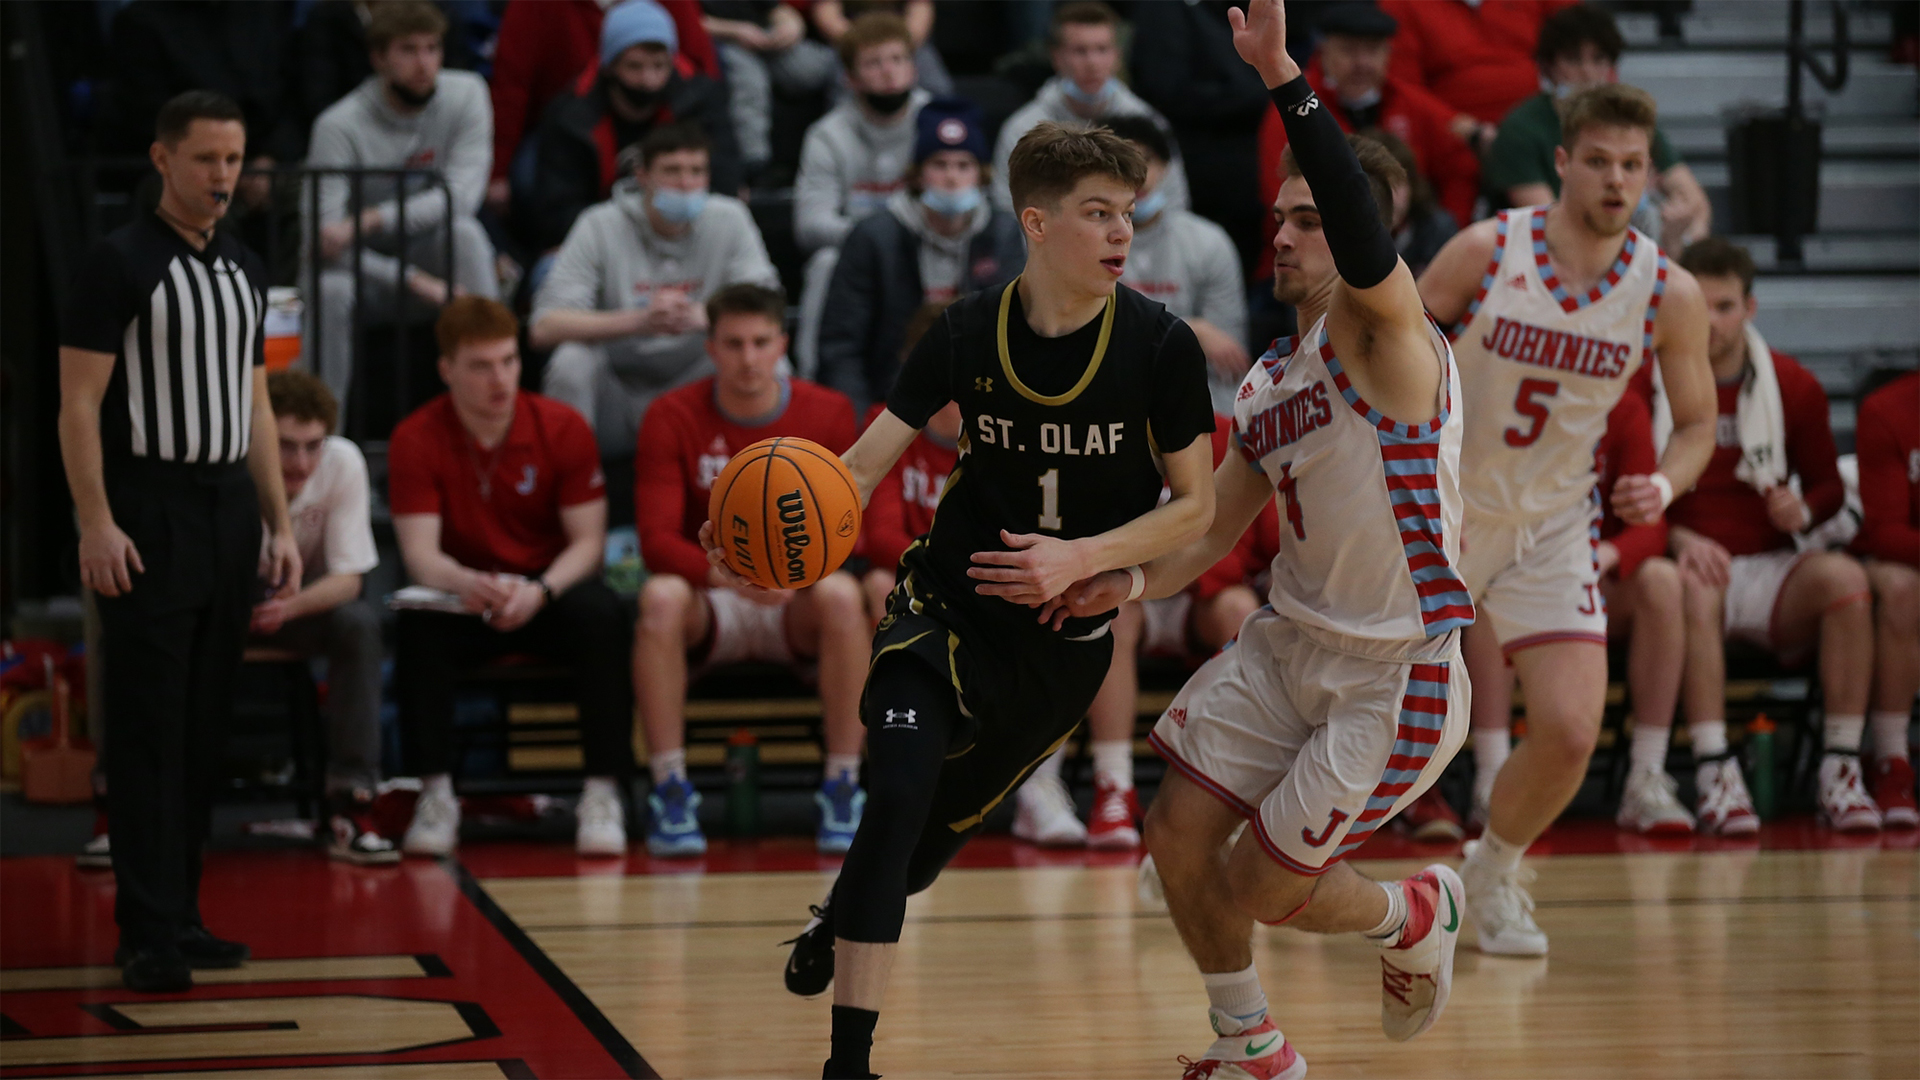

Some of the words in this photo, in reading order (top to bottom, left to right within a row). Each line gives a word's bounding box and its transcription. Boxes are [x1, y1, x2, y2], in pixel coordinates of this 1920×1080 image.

[1482, 316, 1632, 380] JOHNNIES
[977, 414, 1026, 452] ST.
[1040, 422, 1125, 456] OLAF
[1242, 379, 1334, 461] HNNIES
[1503, 376, 1560, 449] 5
[1037, 467, 1063, 531] 1
[776, 487, 812, 585] Wilson
[1578, 583, 1598, 616] J
[1301, 807, 1350, 849] J
